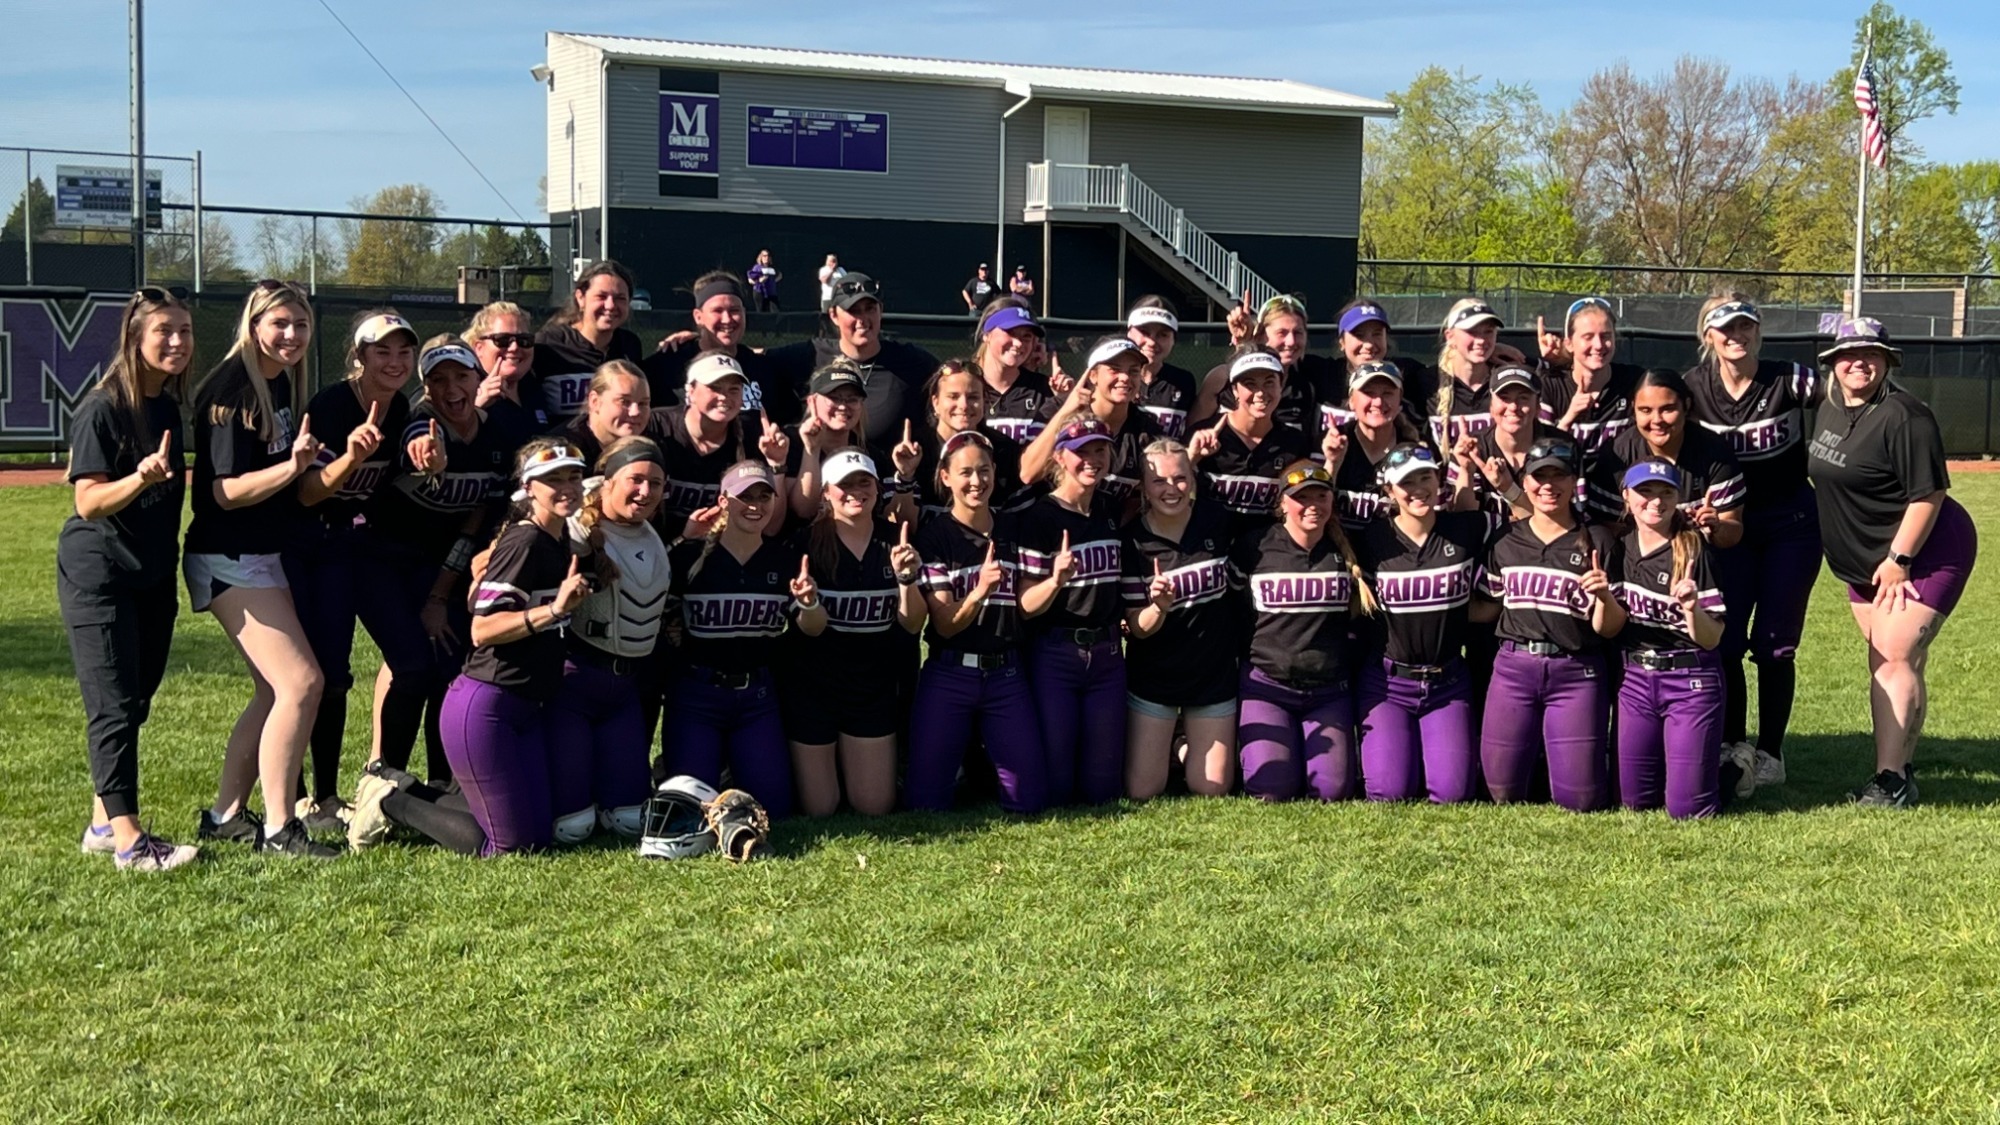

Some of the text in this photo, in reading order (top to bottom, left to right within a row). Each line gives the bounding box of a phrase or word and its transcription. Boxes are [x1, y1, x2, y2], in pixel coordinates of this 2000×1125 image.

[670, 101, 708, 136] M
[670, 136, 708, 146] CLUB
[669, 151, 709, 162] SUPPORTS
[680, 160, 699, 169] YOU!
[1017, 307, 1030, 319] M
[1361, 306, 1376, 315] M
[384, 316, 402, 325] M
[0, 292, 130, 441] M
[717, 357, 731, 366] M
[846, 454, 860, 463] M
[1650, 464, 1666, 475] M
[1214, 479, 1280, 503] AIDER
[1260, 576, 1349, 602] RAIDER
[689, 600, 787, 627] RAIDERS
[821, 595, 898, 622] AIDER
